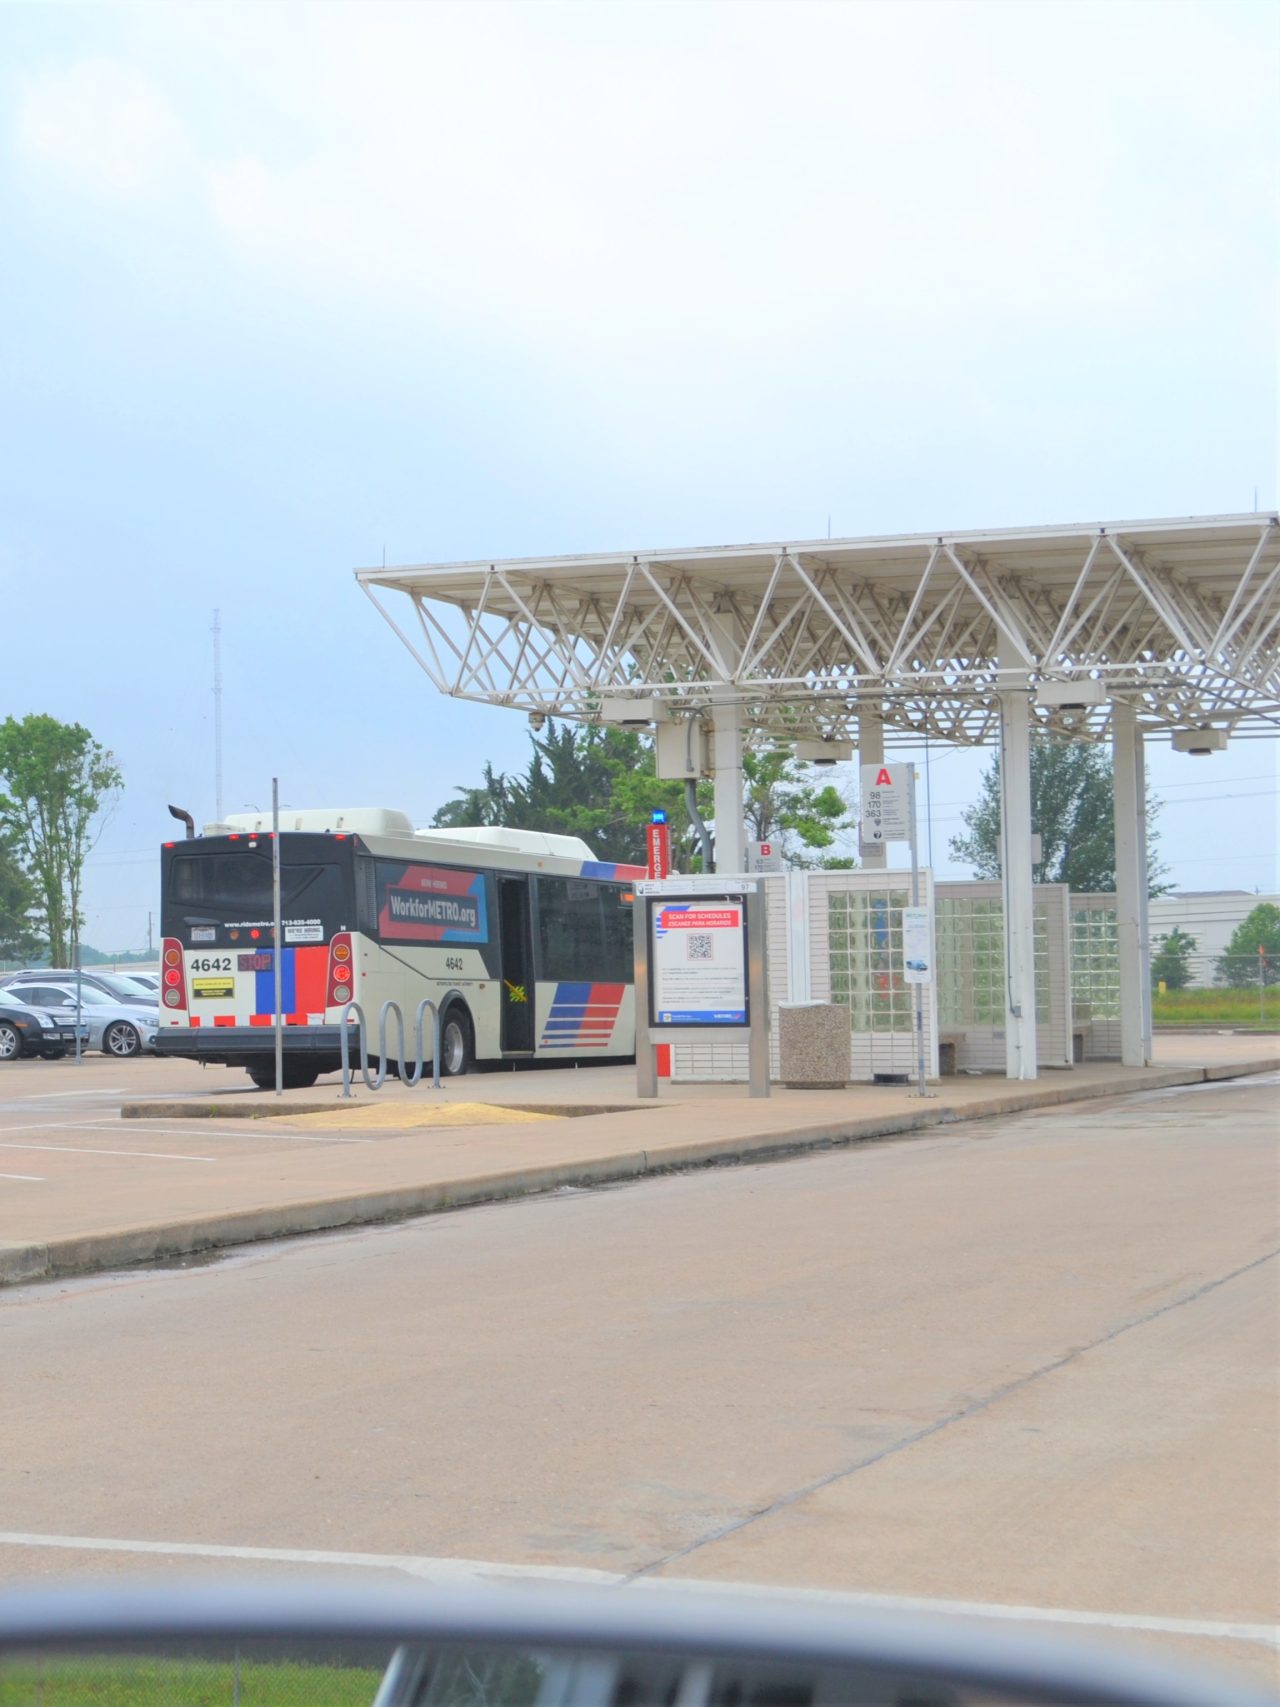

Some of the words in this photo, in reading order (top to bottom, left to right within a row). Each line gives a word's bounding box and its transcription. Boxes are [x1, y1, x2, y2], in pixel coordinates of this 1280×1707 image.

[875, 768, 892, 785] A
[870, 791, 881, 800] 98
[868, 800, 881, 809] 170
[865, 809, 881, 818] 363
[761, 844, 771, 856] B
[390, 895, 476, 927] WorkforMETRO.org
[191, 957, 232, 972] 4642
[239, 955, 271, 970] STOP
[445, 957, 463, 970] 4642
